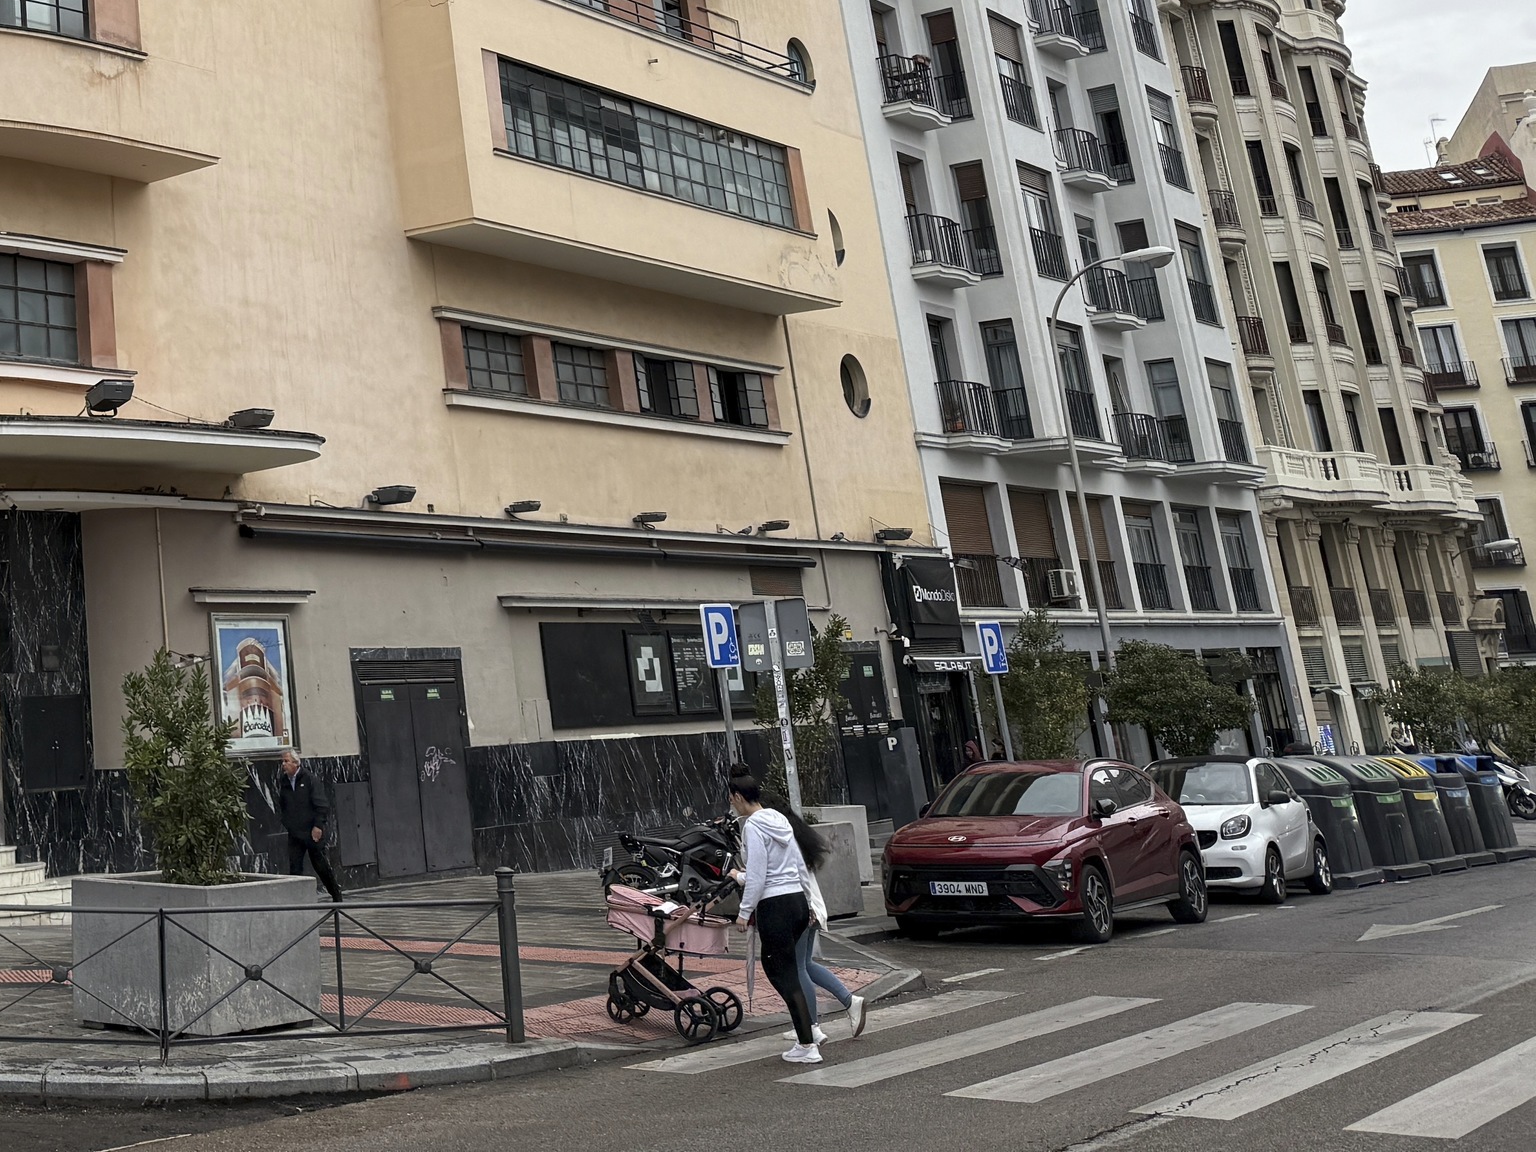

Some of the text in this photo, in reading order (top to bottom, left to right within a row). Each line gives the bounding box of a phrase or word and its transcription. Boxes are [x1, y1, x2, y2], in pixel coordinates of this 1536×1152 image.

[707, 612, 729, 661] P
[982, 628, 999, 668] P
[934, 661, 972, 671] SALA BUT
[887, 736, 898, 751] P
[937, 883, 984, 894] 3904 MND
